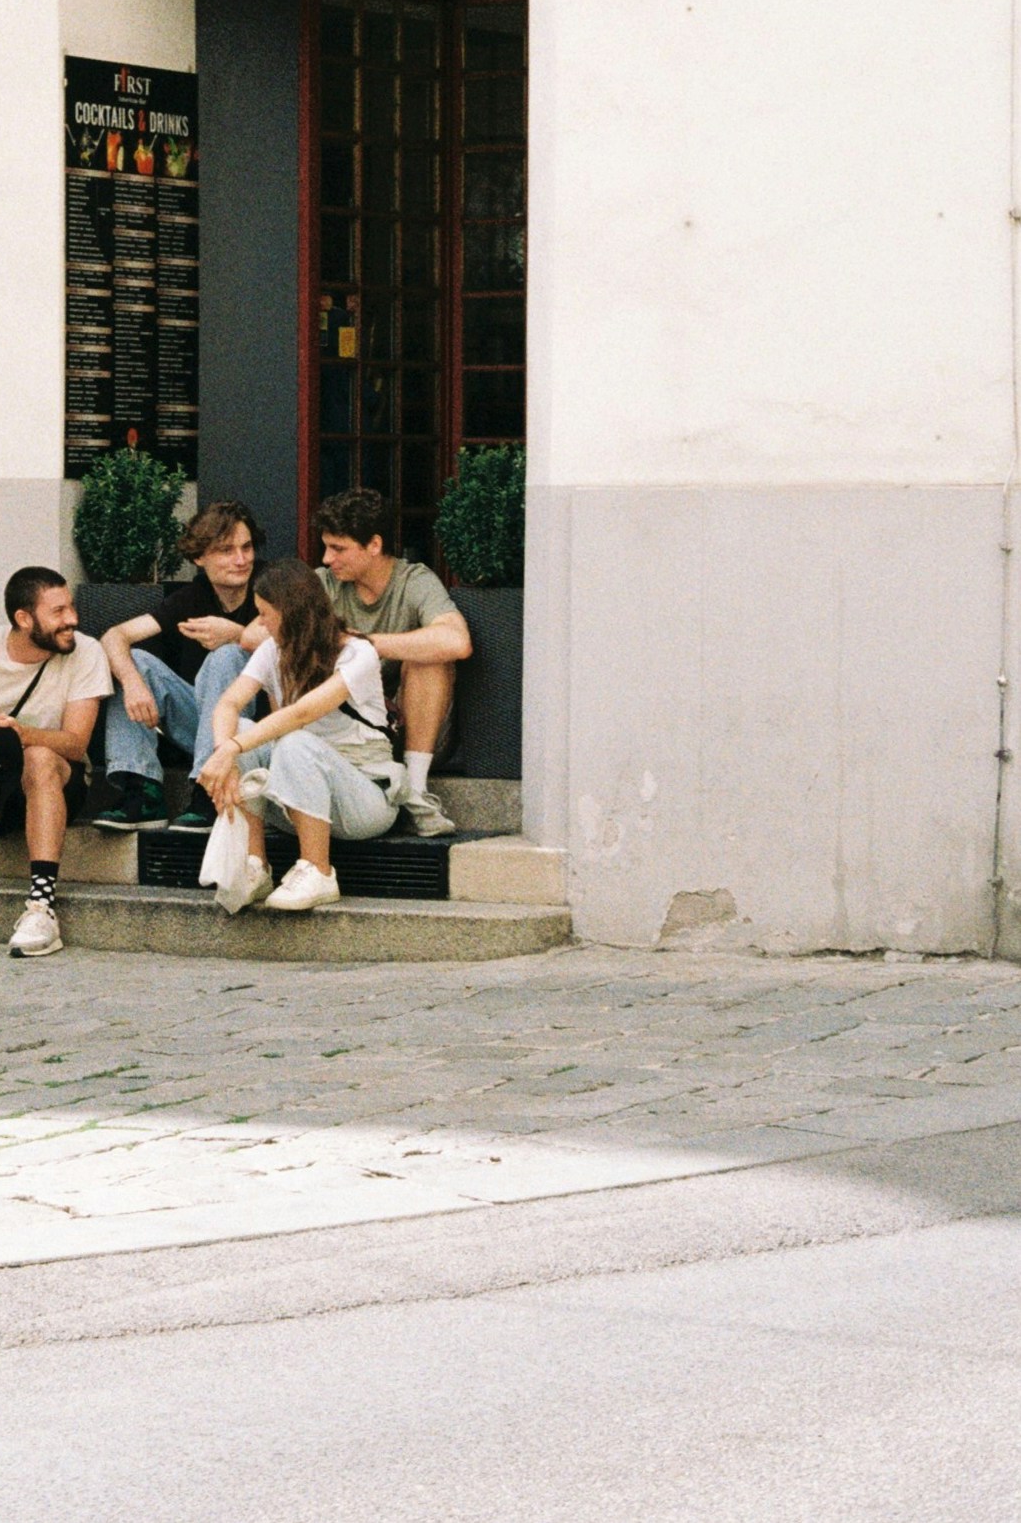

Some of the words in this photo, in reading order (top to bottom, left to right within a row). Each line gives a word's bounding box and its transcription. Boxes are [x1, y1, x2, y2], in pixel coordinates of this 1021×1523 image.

[75, 101, 135, 131] COCKTAILS
[138, 109, 146, 132] &
[149, 111, 189, 137] DRINKS
